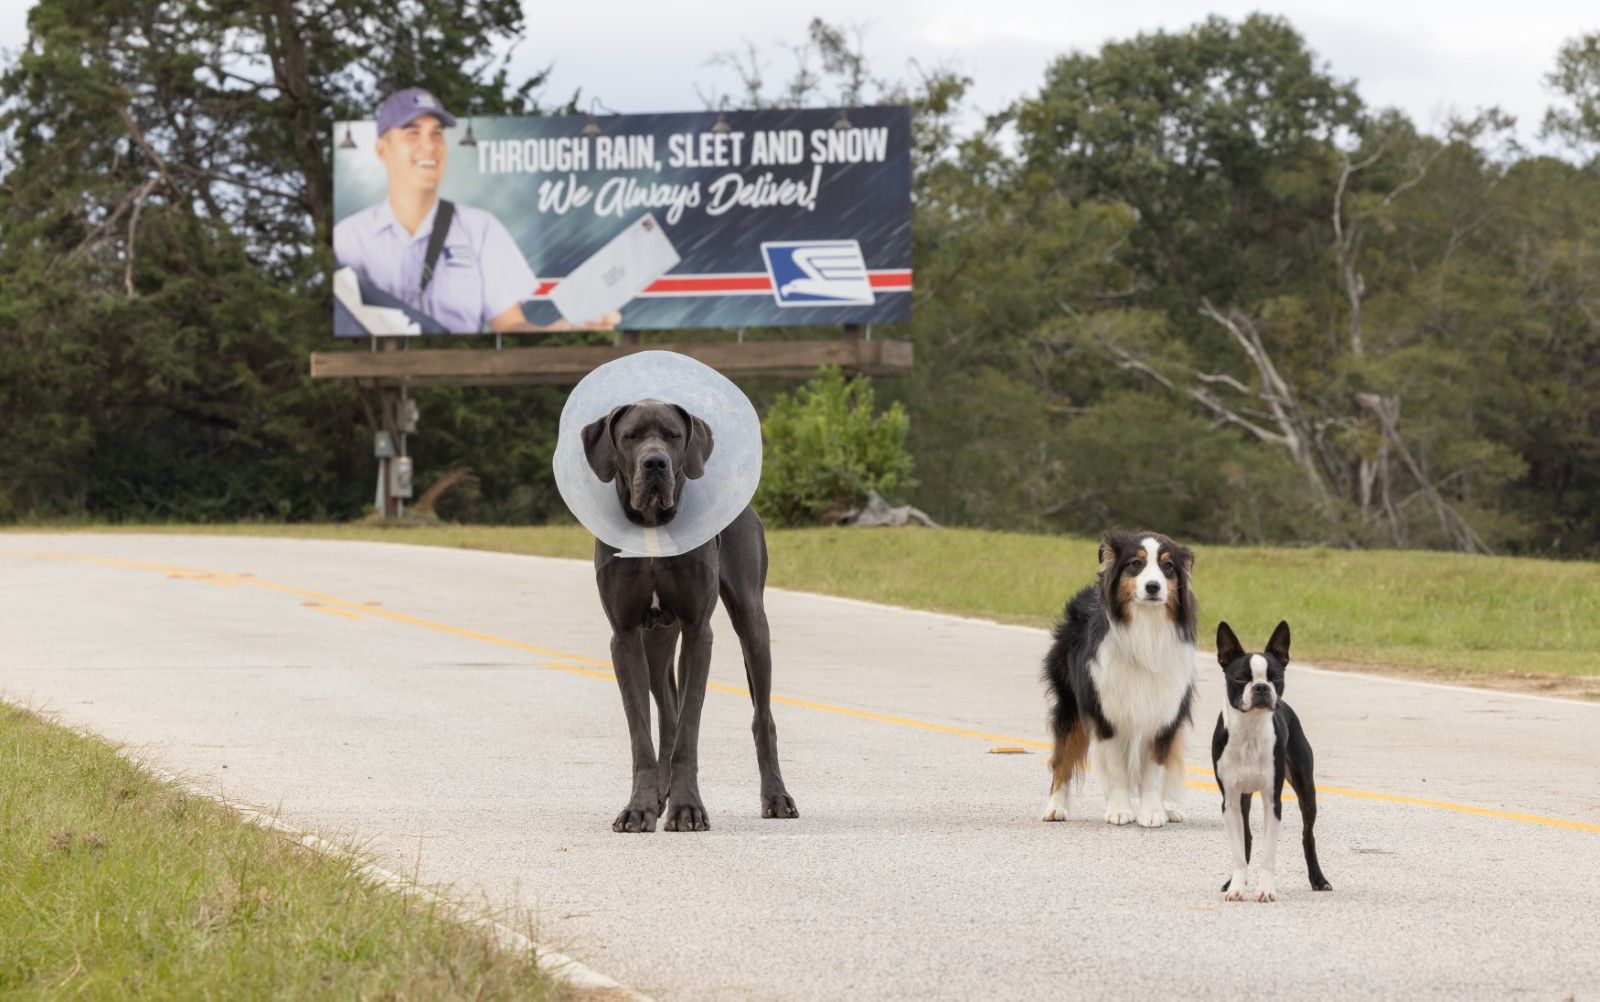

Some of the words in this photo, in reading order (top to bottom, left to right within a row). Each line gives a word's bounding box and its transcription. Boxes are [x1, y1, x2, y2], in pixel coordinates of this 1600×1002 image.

[477, 136, 589, 173] THROUGH
[596, 134, 661, 172] RAIN,
[669, 131, 745, 168] SLEET
[751, 129, 804, 165] AND
[811, 127, 888, 164] SNOW
[538, 173, 592, 215] We
[594, 175, 701, 225] Always
[706, 165, 820, 215] Deliver!
